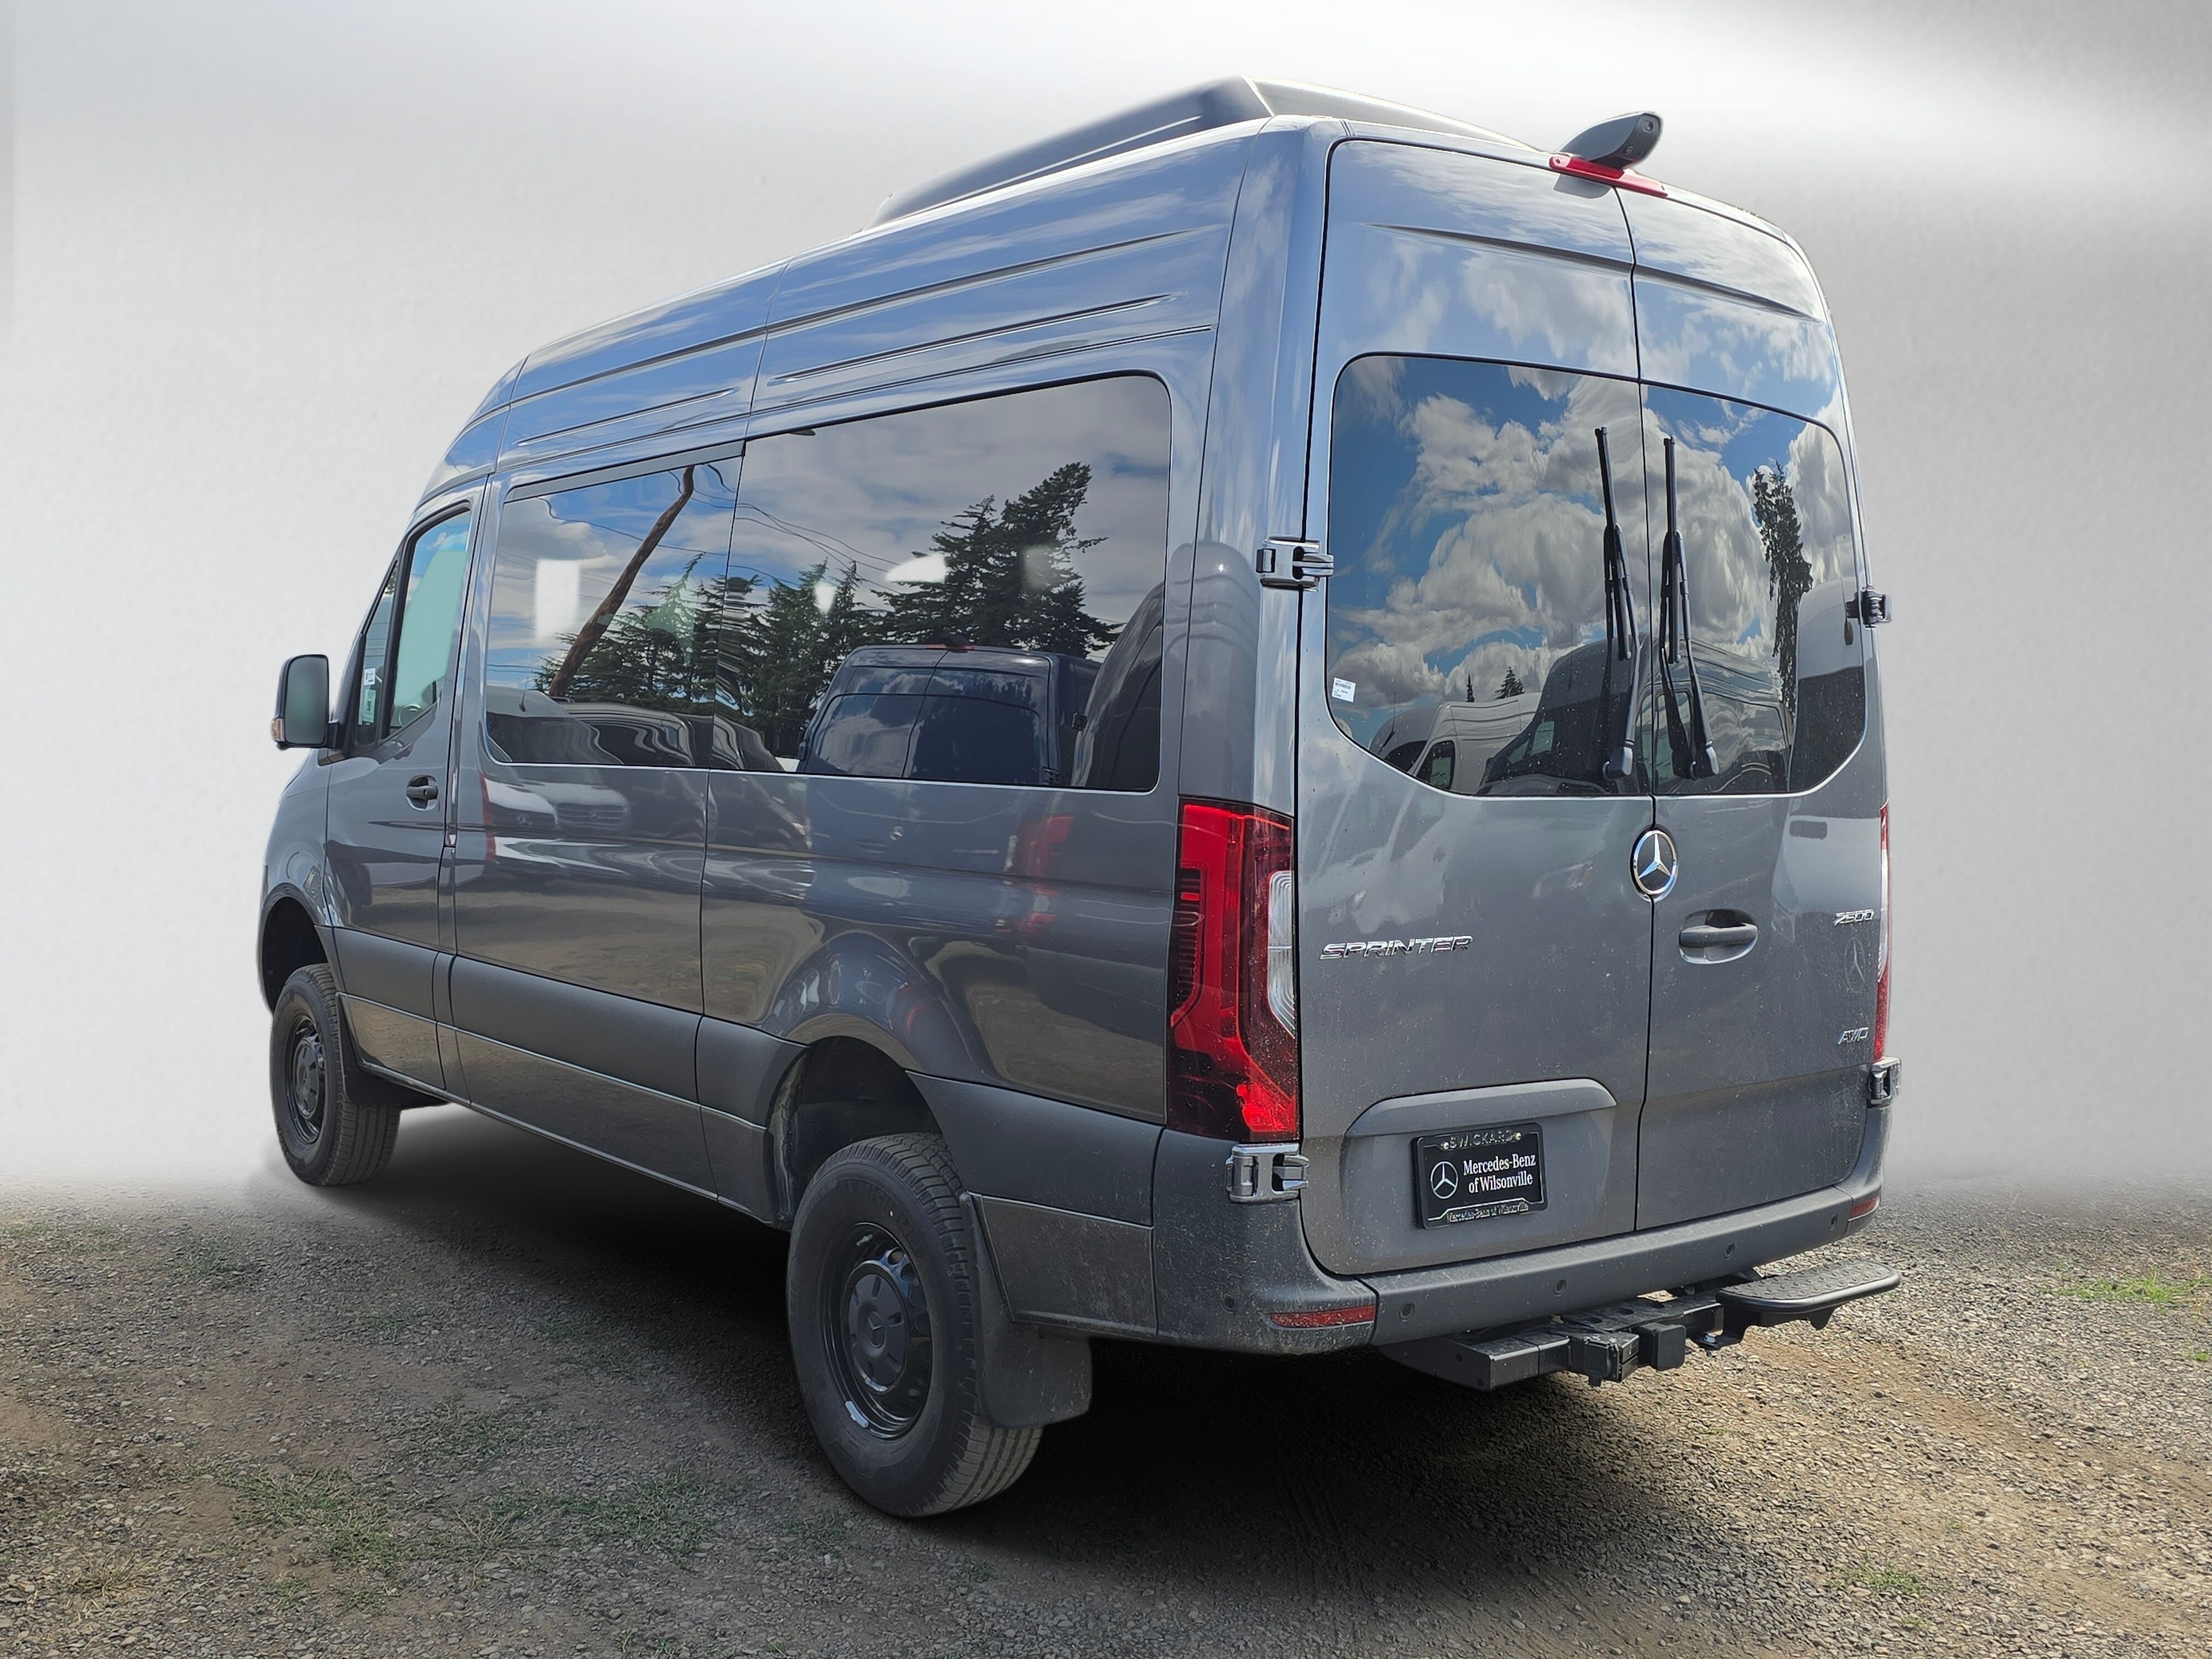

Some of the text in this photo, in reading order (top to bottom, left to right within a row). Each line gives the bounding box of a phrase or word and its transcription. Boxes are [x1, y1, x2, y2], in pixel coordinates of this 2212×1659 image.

[1833, 909, 1874, 926] 2500
[1320, 936, 1473, 960] SPRINTER
[1463, 1153, 1536, 1176] Mercedes-Benz
[1468, 1171, 1533, 1193] of Wilsonville
